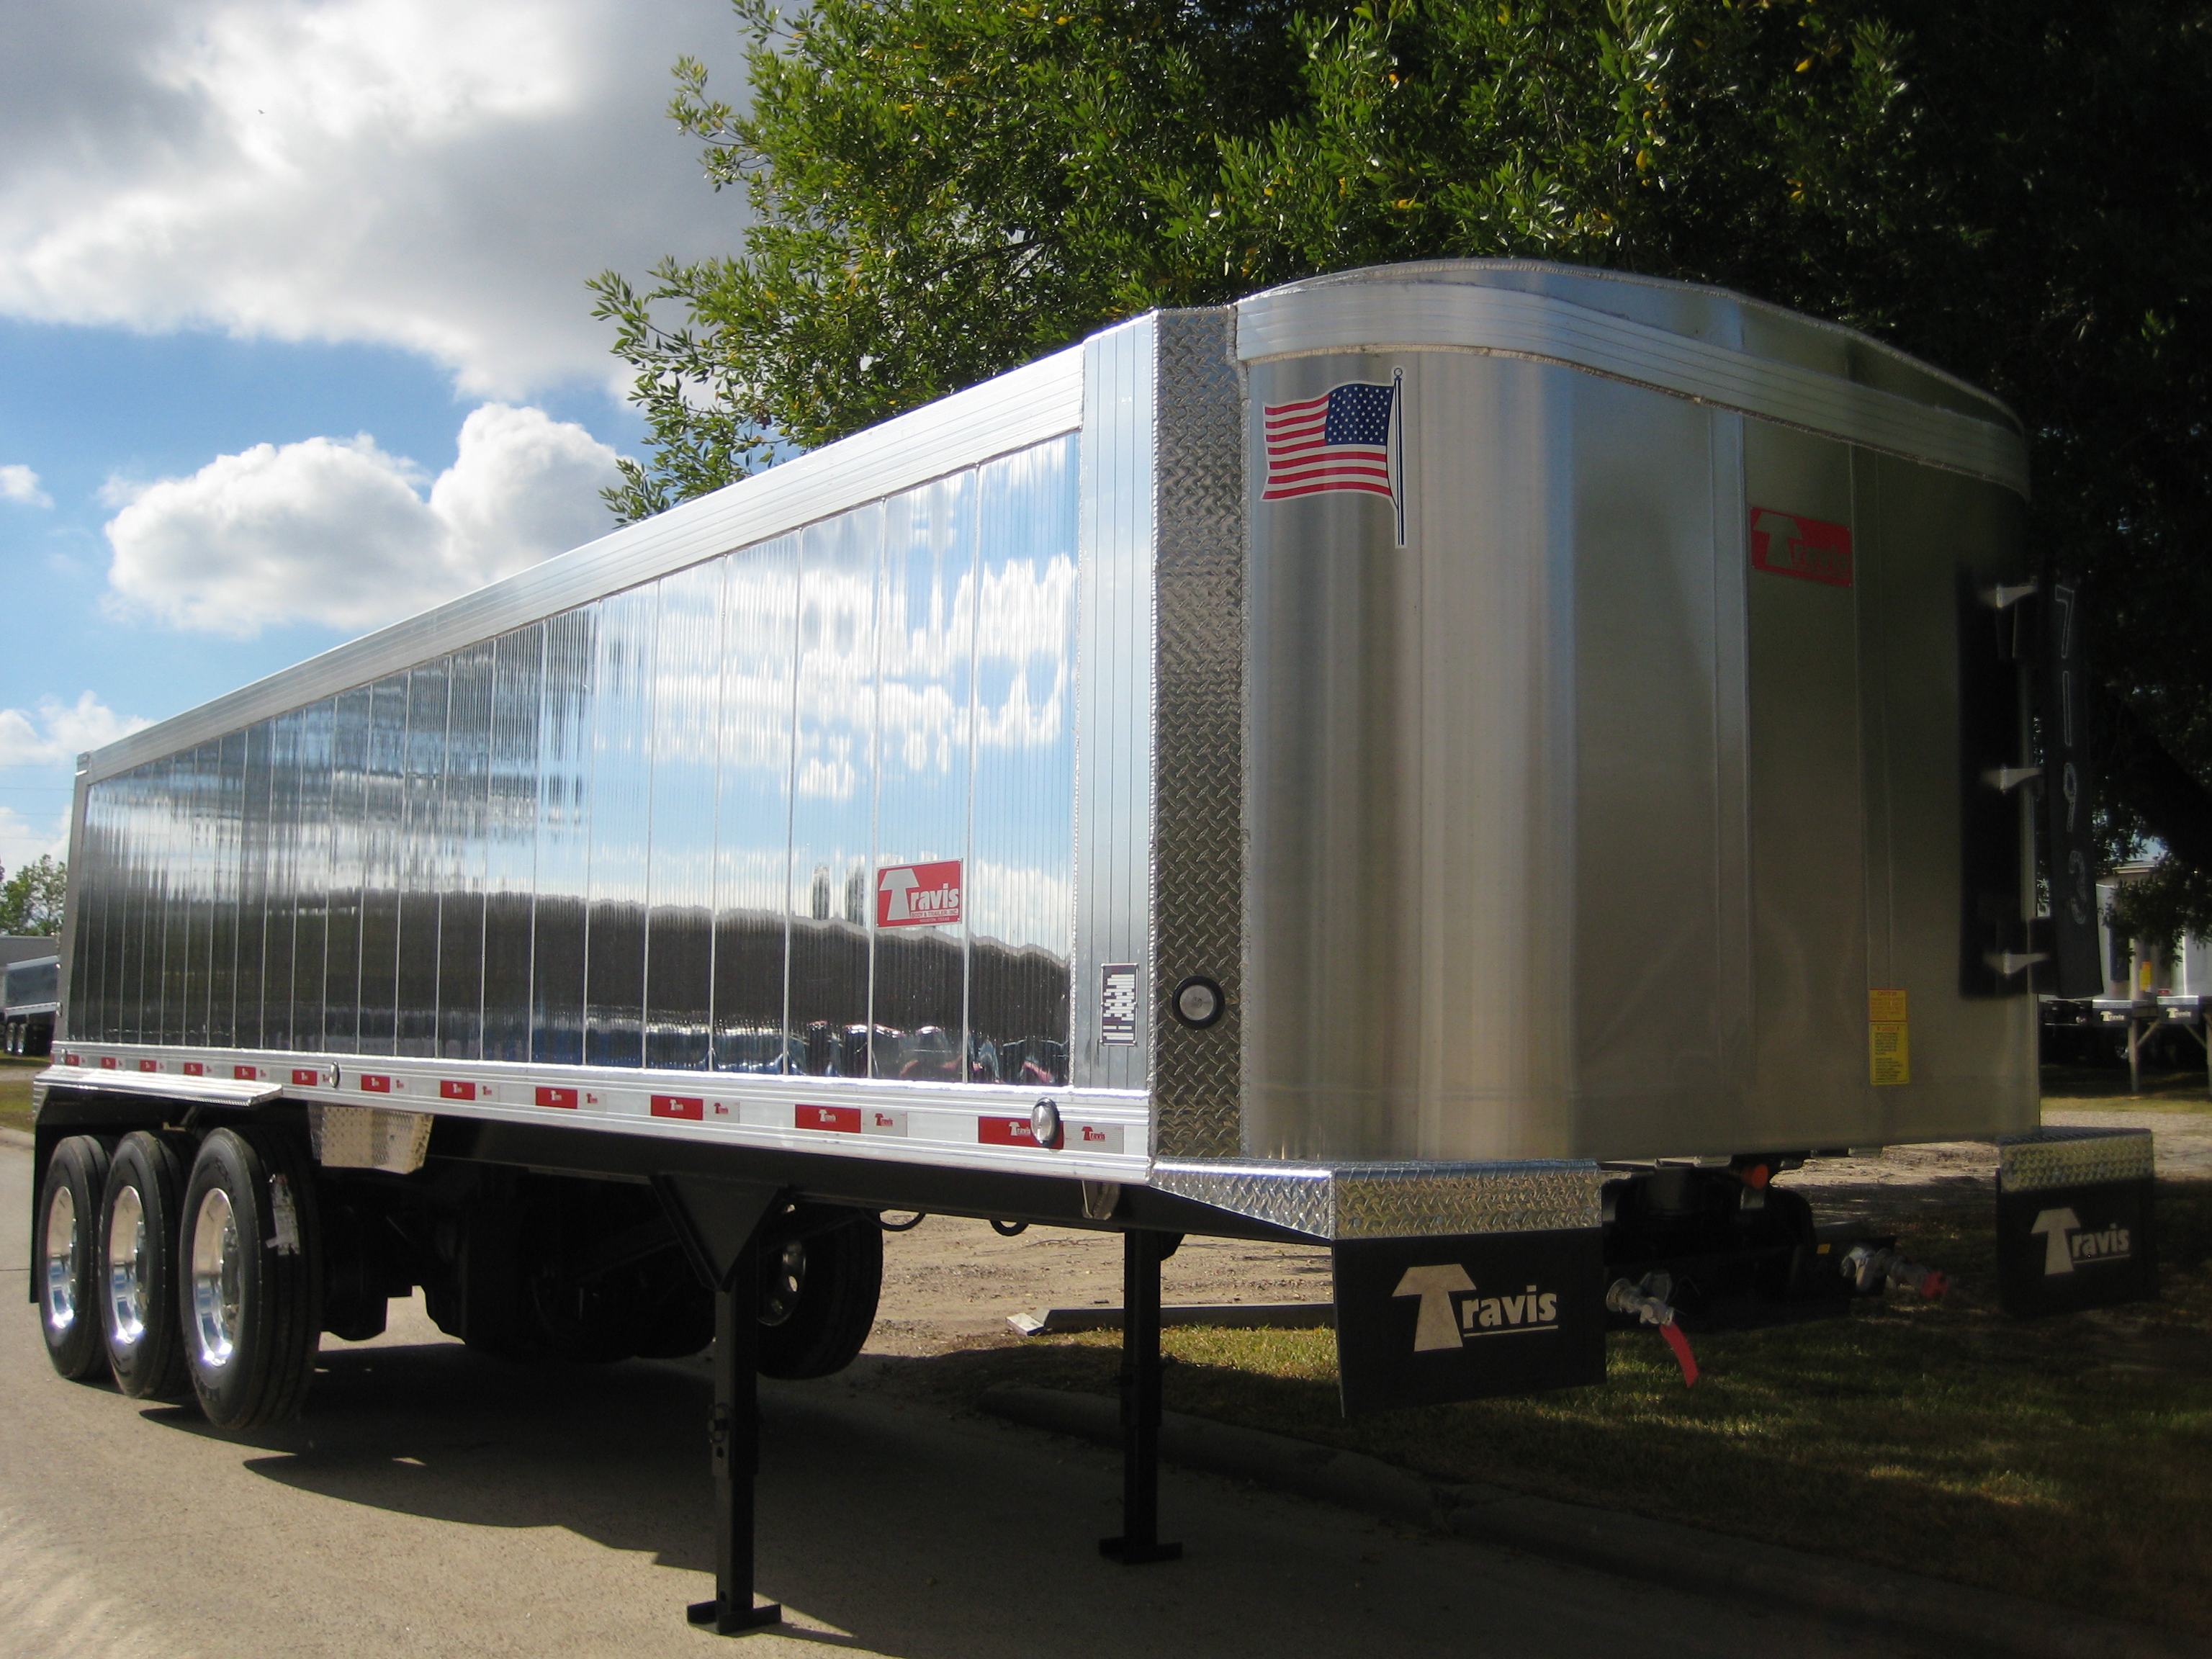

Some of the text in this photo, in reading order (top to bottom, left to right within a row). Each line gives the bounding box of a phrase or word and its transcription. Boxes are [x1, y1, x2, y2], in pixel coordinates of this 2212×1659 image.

[1753, 511, 1850, 572] Travis
[878, 868, 959, 921] Travis
[2030, 1207, 2130, 1275] Travis
[1391, 1263, 1558, 1352] Travis
